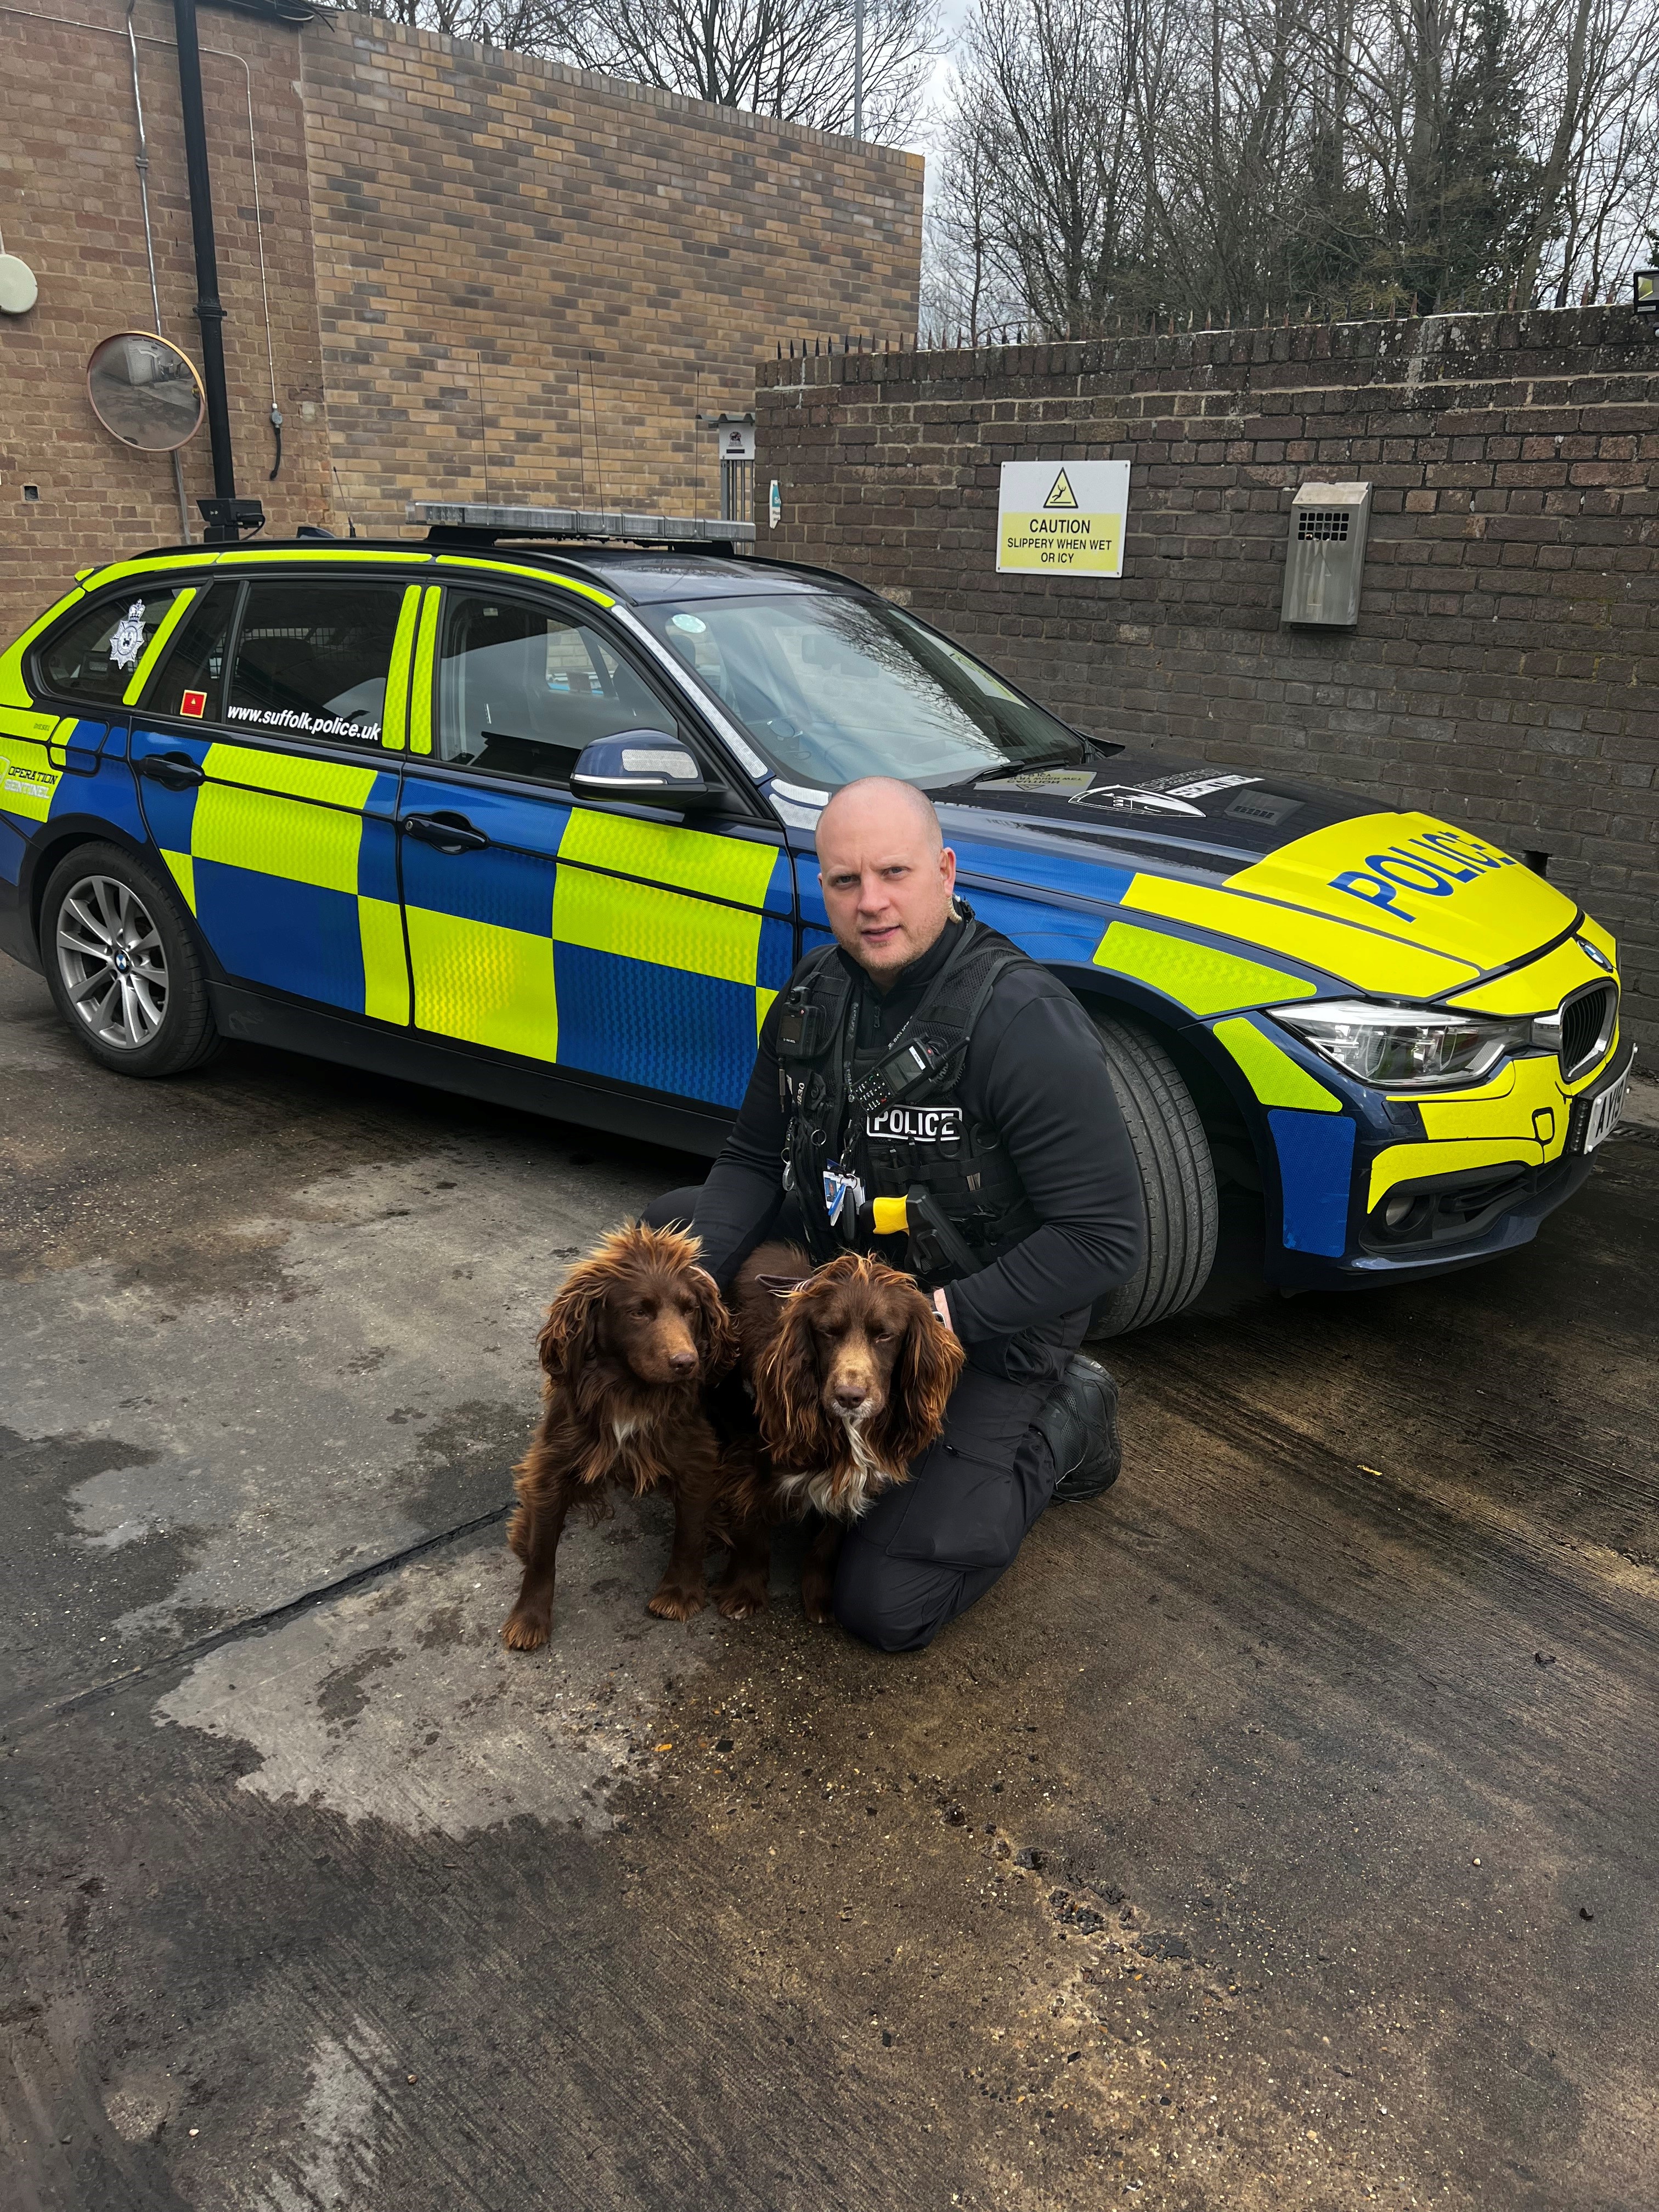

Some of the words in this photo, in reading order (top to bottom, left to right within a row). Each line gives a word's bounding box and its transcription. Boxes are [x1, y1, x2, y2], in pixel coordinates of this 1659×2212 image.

[1029, 518, 1091, 534] CAUTION
[1007, 537, 1054, 549] SLIPPERY
[1057, 539, 1087, 550] WHEN
[1090, 540, 1112, 551] WET
[1041, 552, 1055, 563] OR
[1058, 552, 1074, 563] ICY
[227, 705, 381, 741] www.suffolk.police.uk
[8, 766, 58, 785] OPERATION
[4, 779, 50, 799] SENTINEL
[1327, 830, 1517, 924] POLICE
[874, 1109, 954, 1136] POLICE
